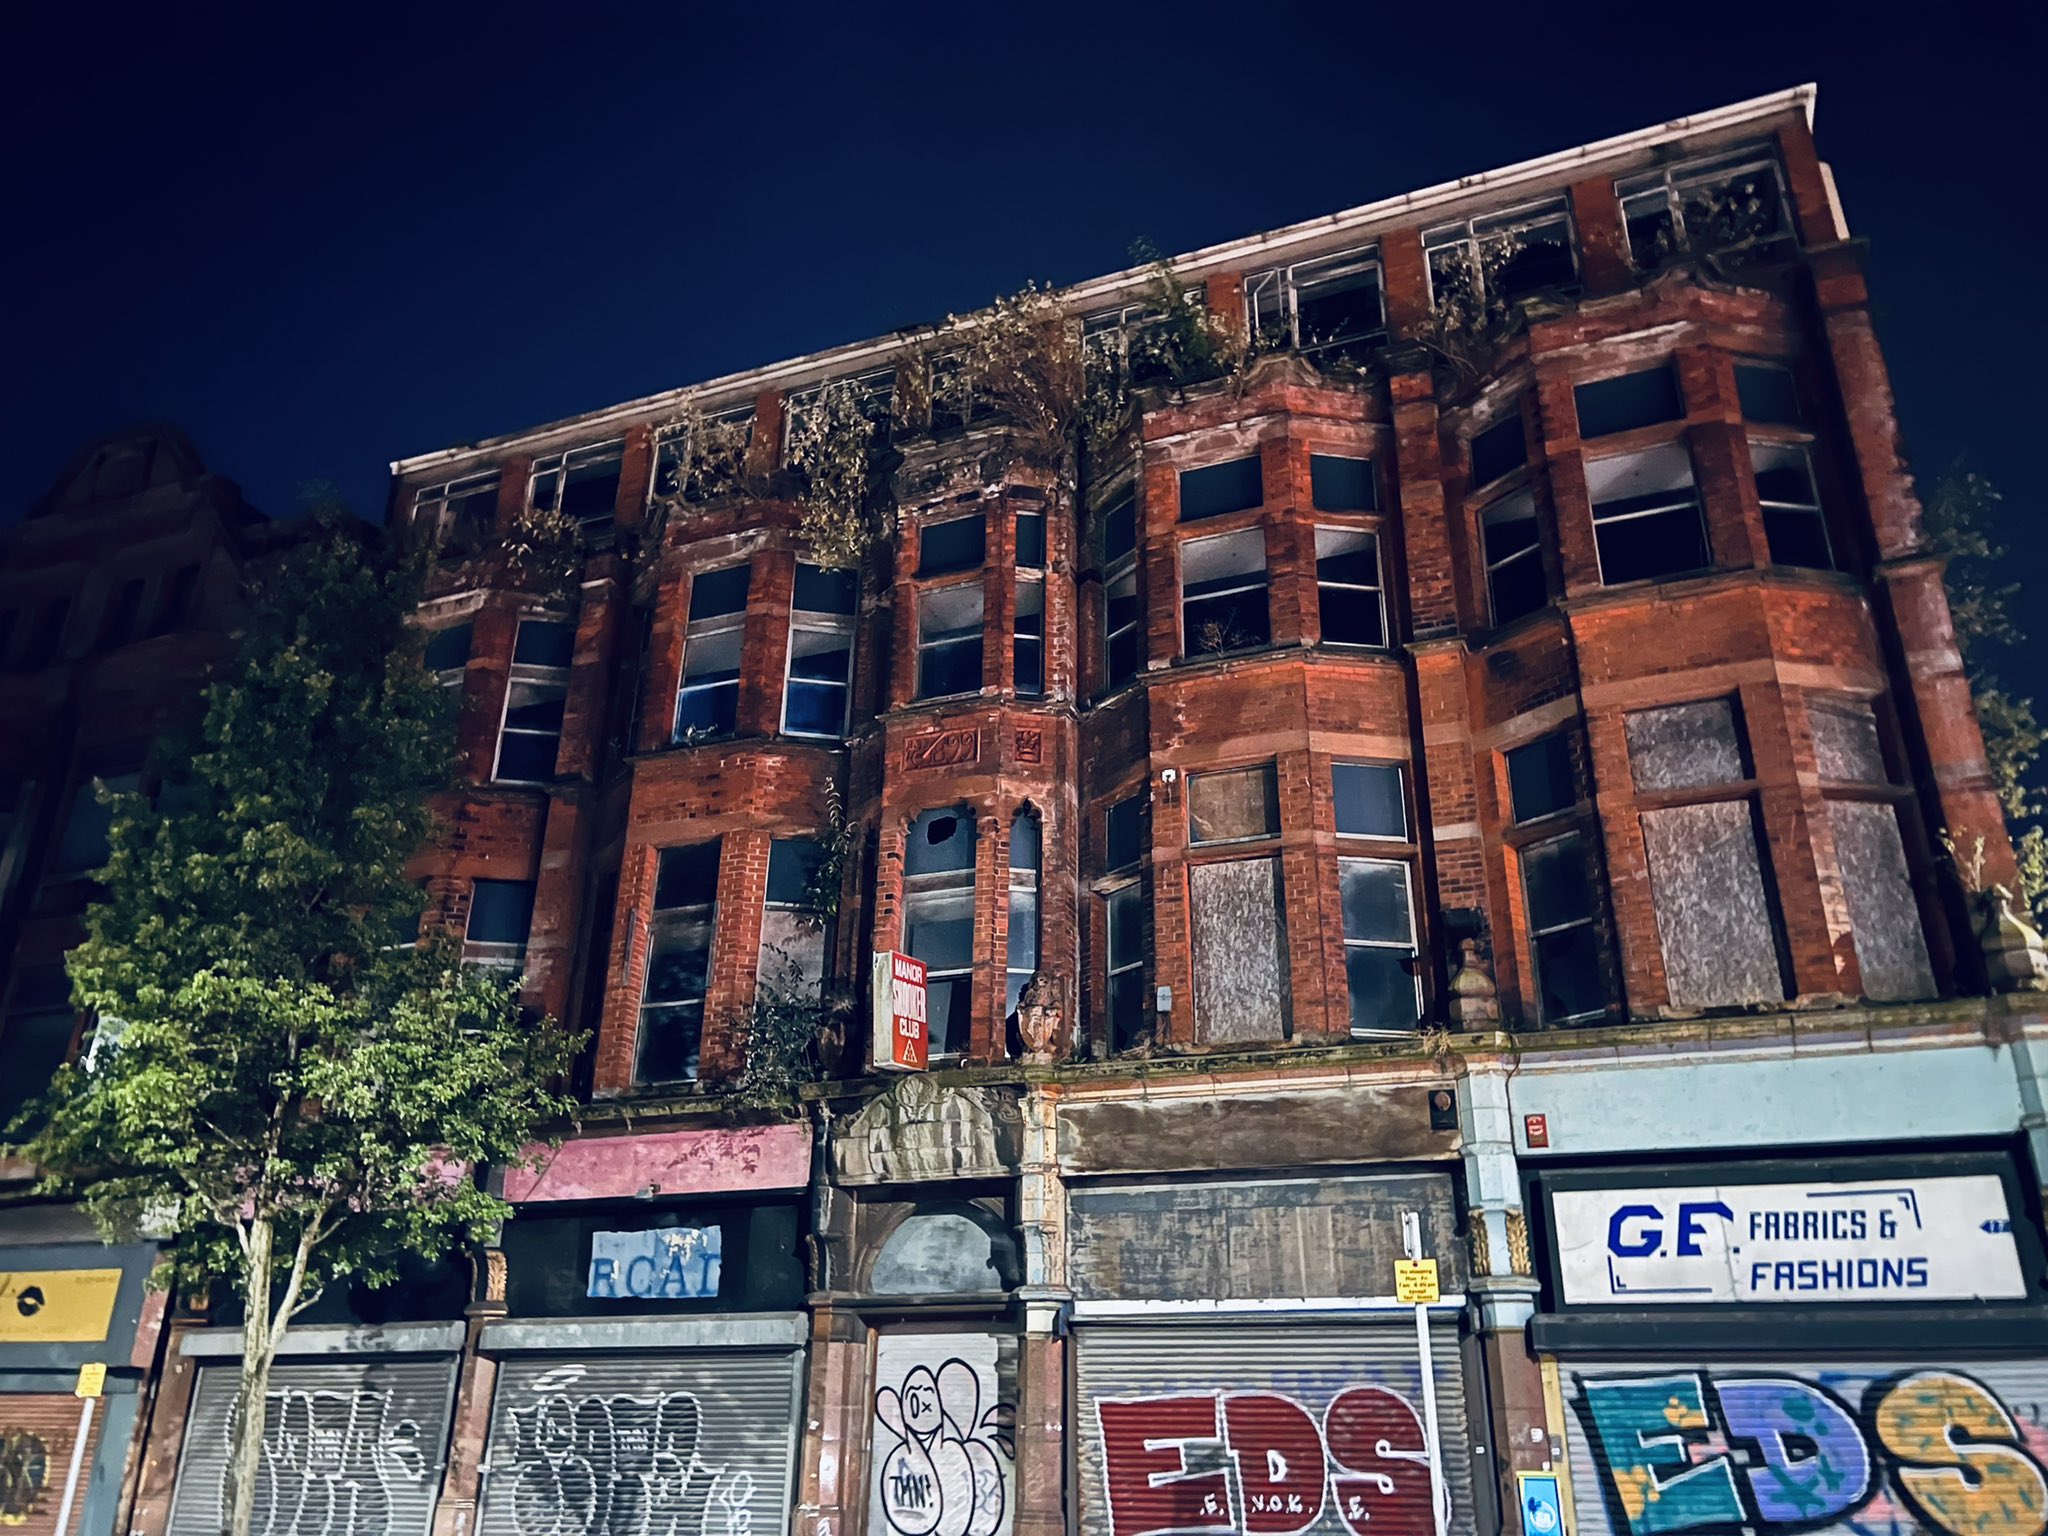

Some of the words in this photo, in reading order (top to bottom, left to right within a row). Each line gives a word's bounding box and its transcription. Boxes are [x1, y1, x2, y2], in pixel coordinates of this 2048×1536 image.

[895, 958, 923, 984] MANOR
[892, 978, 927, 1024] SNOOKER
[899, 1018, 920, 1039] CLUB
[1749, 1209, 1866, 1240] FABRICS
[1879, 1209, 1897, 1239] &
[1751, 1256, 1929, 1292] FASHIONS
